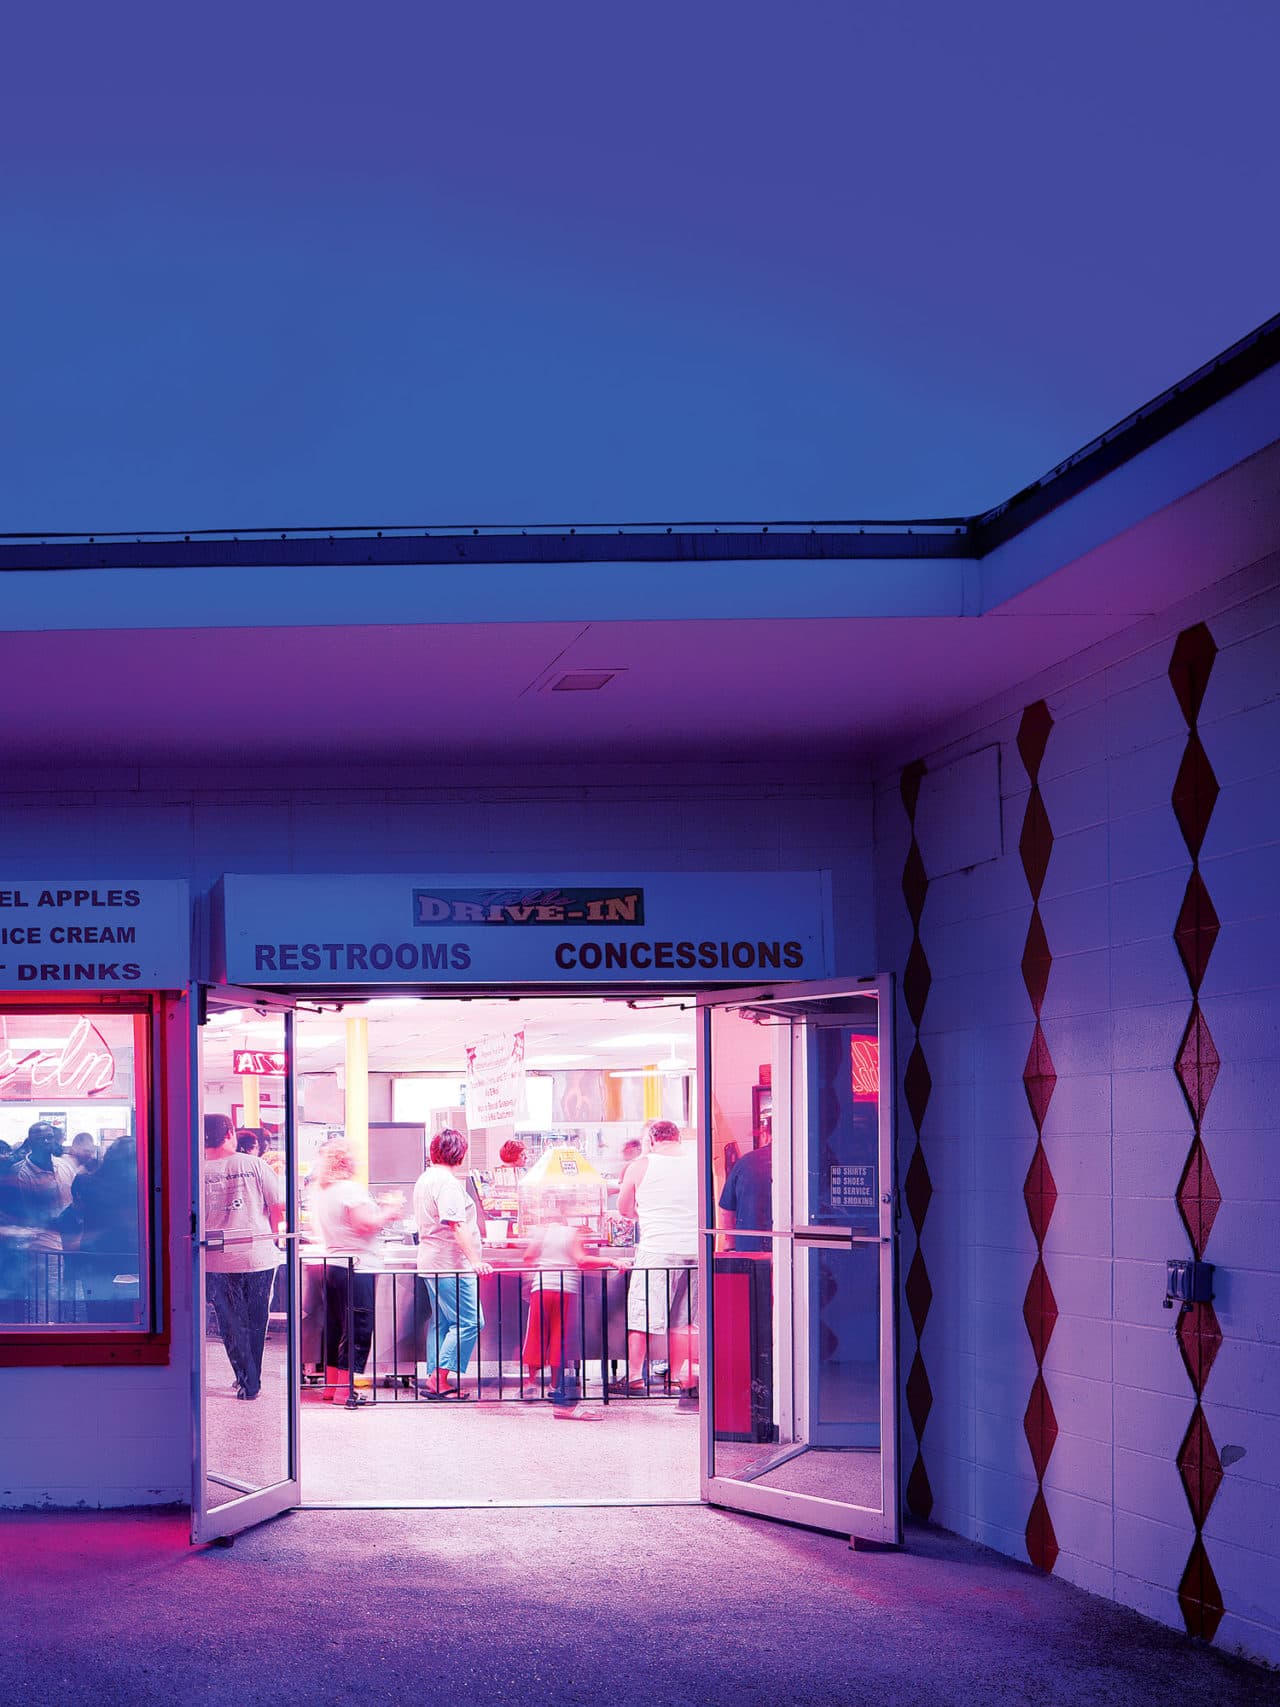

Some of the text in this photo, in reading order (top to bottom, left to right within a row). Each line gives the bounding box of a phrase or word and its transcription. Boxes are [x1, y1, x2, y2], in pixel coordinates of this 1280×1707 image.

[37, 889, 141, 907] APPLES
[418, 894, 638, 921] DRIVE-IN
[1, 926, 137, 945] ICE CREAM
[255, 941, 804, 970] RESTROOMS CONCESSIONS
[17, 963, 142, 982] DRINKS
[832, 1177, 865, 1185] NO SHOES
[832, 1186, 871, 1195] NO SERVICE
[832, 1196, 873, 1205] NO SMOKING
